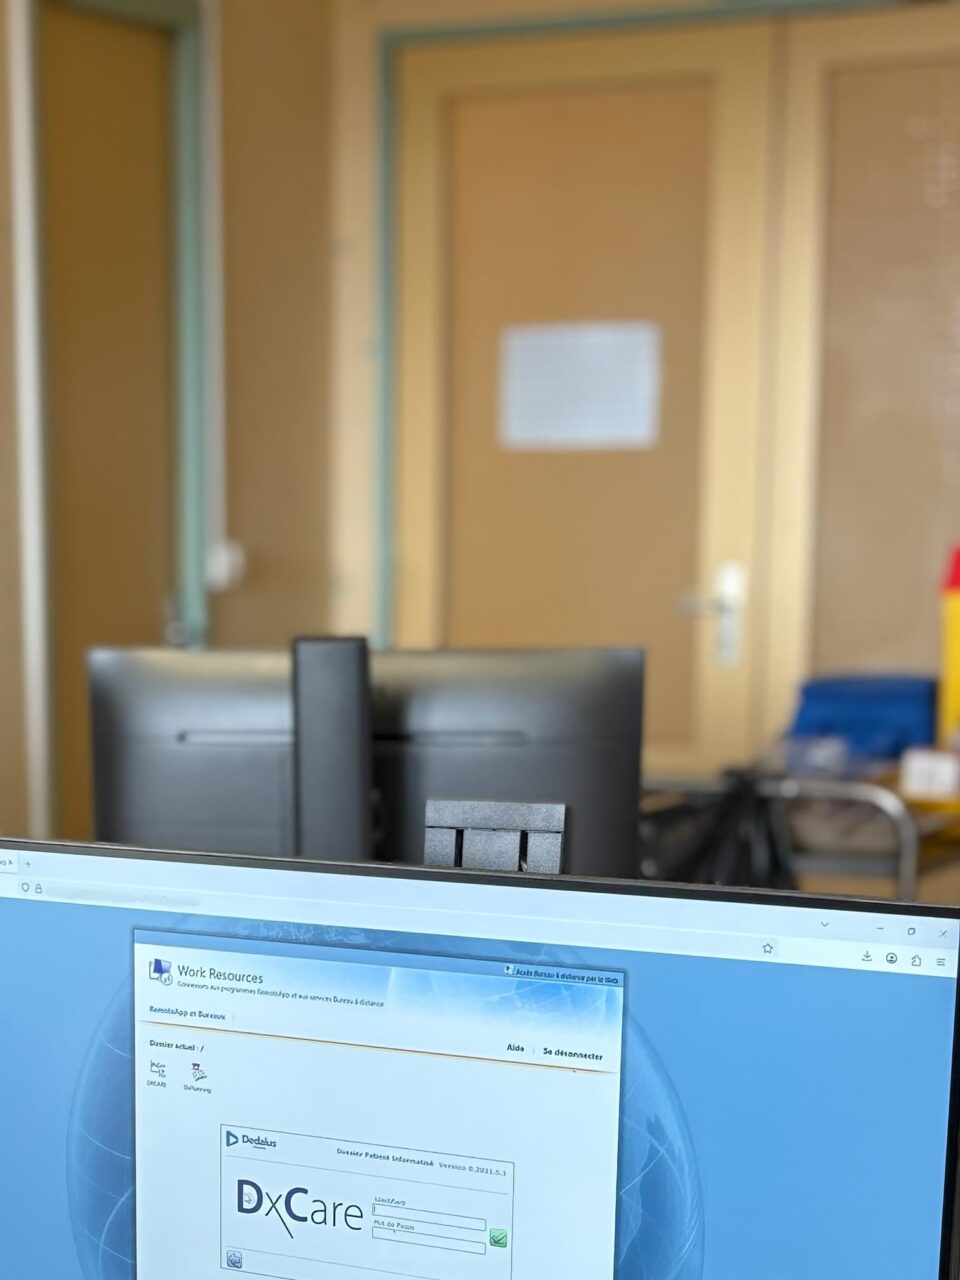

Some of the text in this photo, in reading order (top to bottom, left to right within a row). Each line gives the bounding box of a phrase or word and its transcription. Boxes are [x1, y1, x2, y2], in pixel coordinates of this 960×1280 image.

[177, 965, 264, 984] Work Resources
[149, 1005, 188, 1017] RemoteApp
[506, 1043, 525, 1052] Aide
[543, 1047, 603, 1061] Se déconnecter
[241, 1134, 277, 1148] Dedalus
[237, 1179, 364, 1239] DxCare
